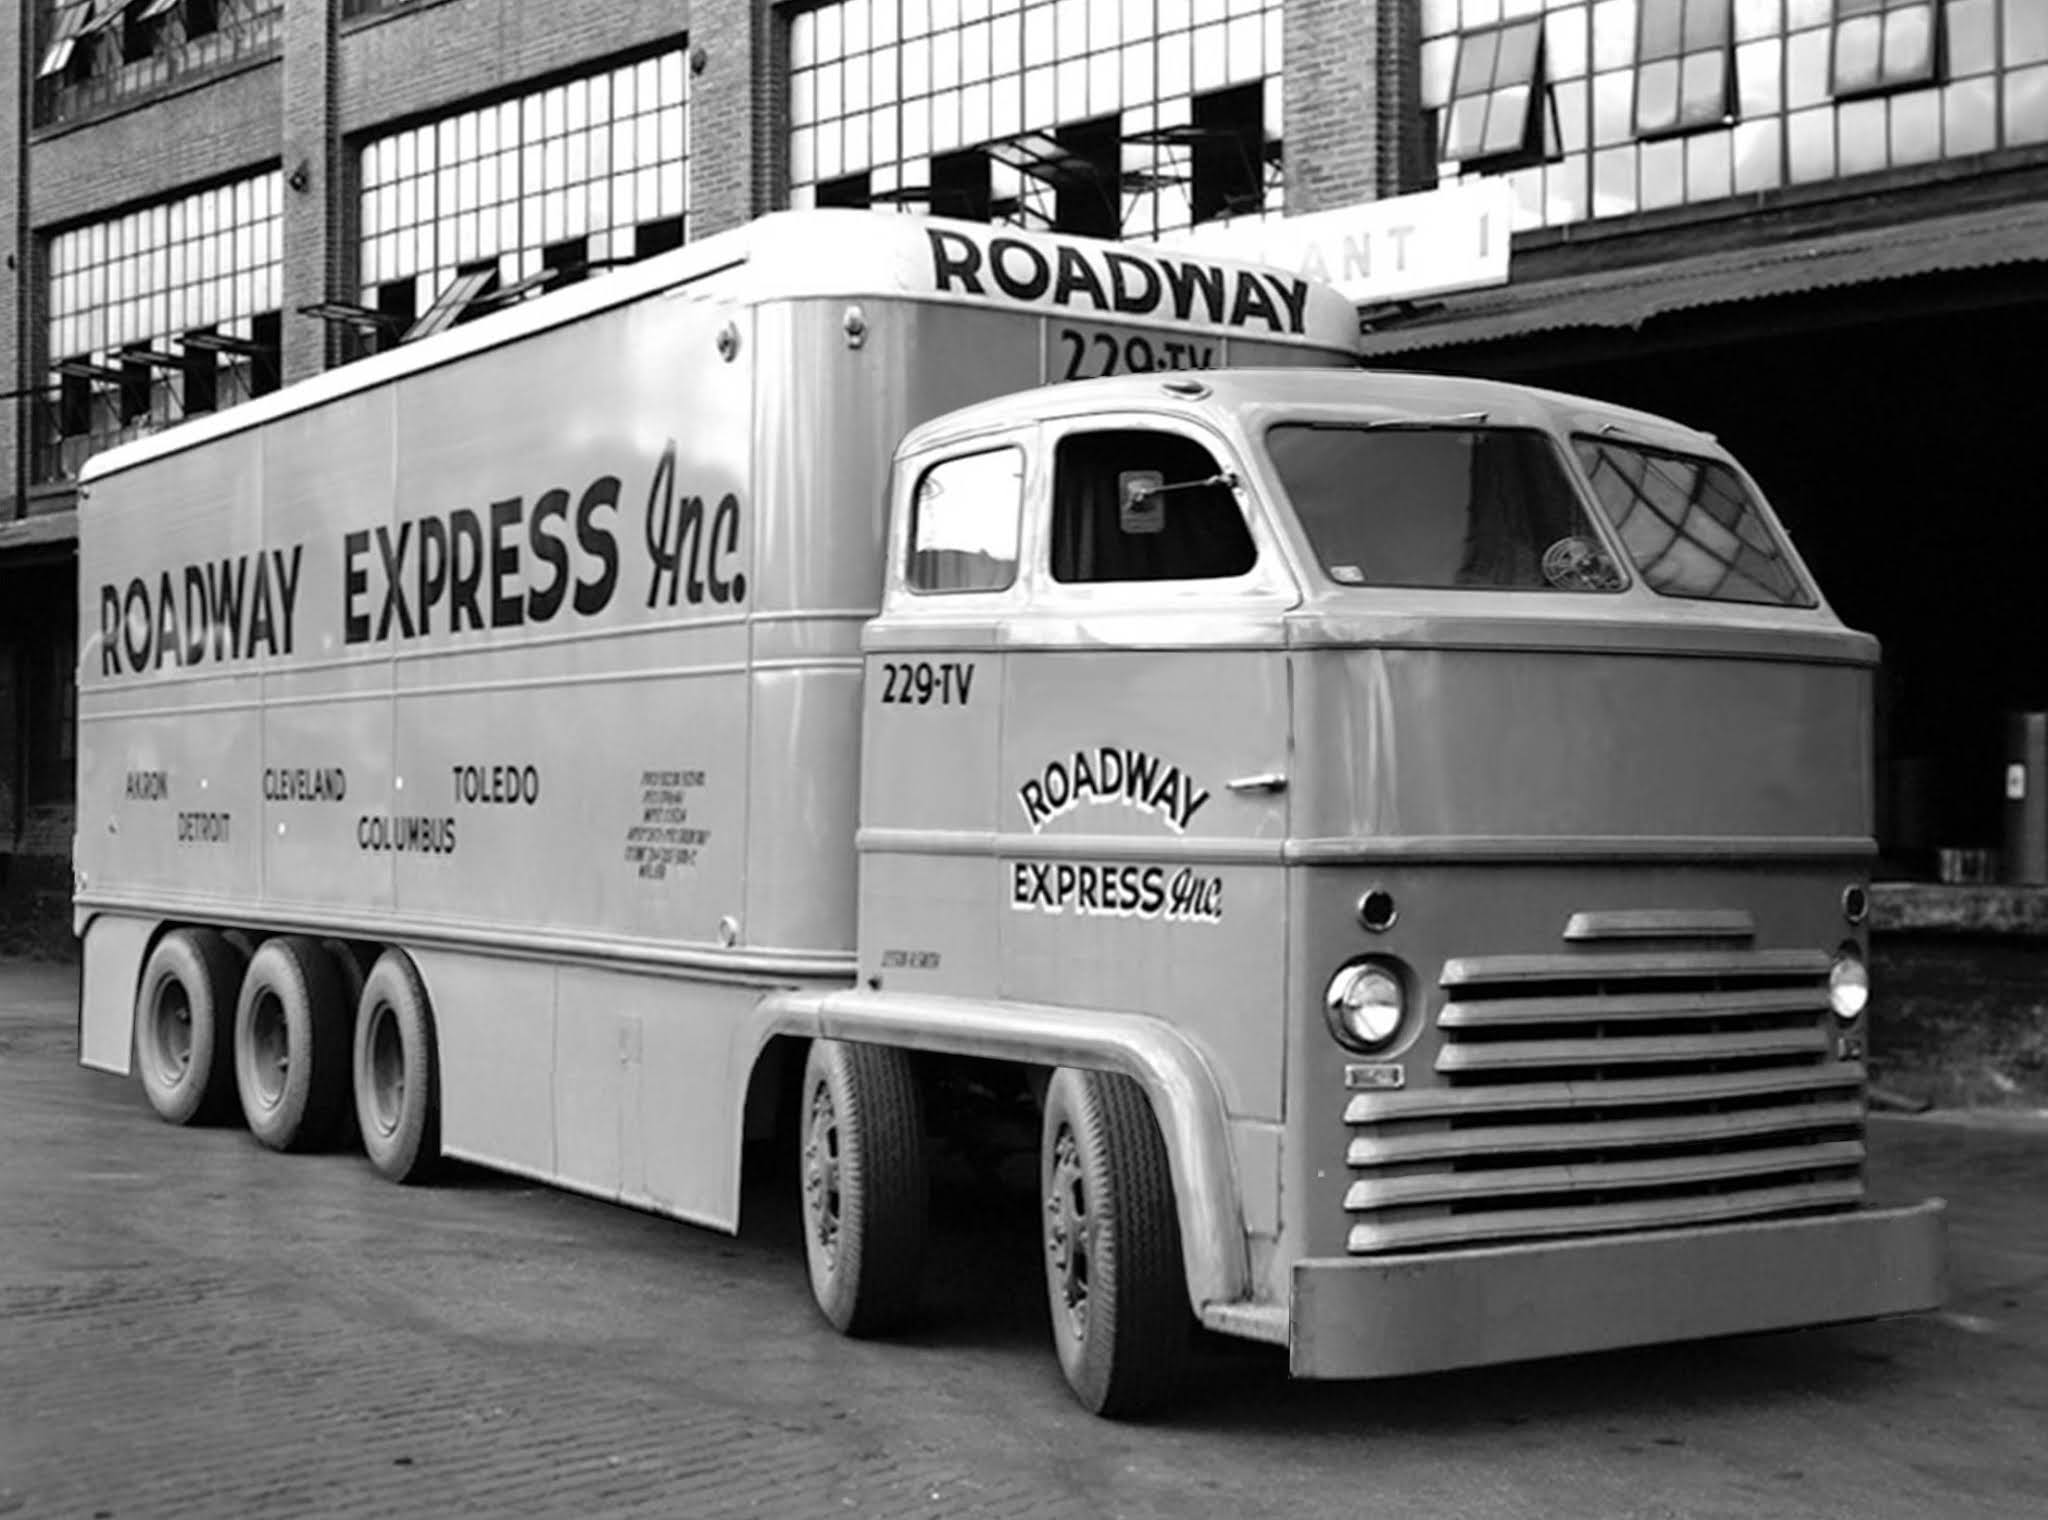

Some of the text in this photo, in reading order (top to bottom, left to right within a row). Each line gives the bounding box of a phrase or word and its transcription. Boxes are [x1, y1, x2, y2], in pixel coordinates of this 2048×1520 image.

[928, 229, 1307, 334] ROADWAY
[101, 438, 746, 676] ROADWAY EXPRESS Inc.
[126, 765, 539, 805] AKRON CLEVELAND TOLEDO
[1019, 746, 1210, 829] ROADWAY
[178, 812, 456, 854] DETROIT COLUMBUS
[1014, 864, 1223, 918] EXPRESS Inc.
